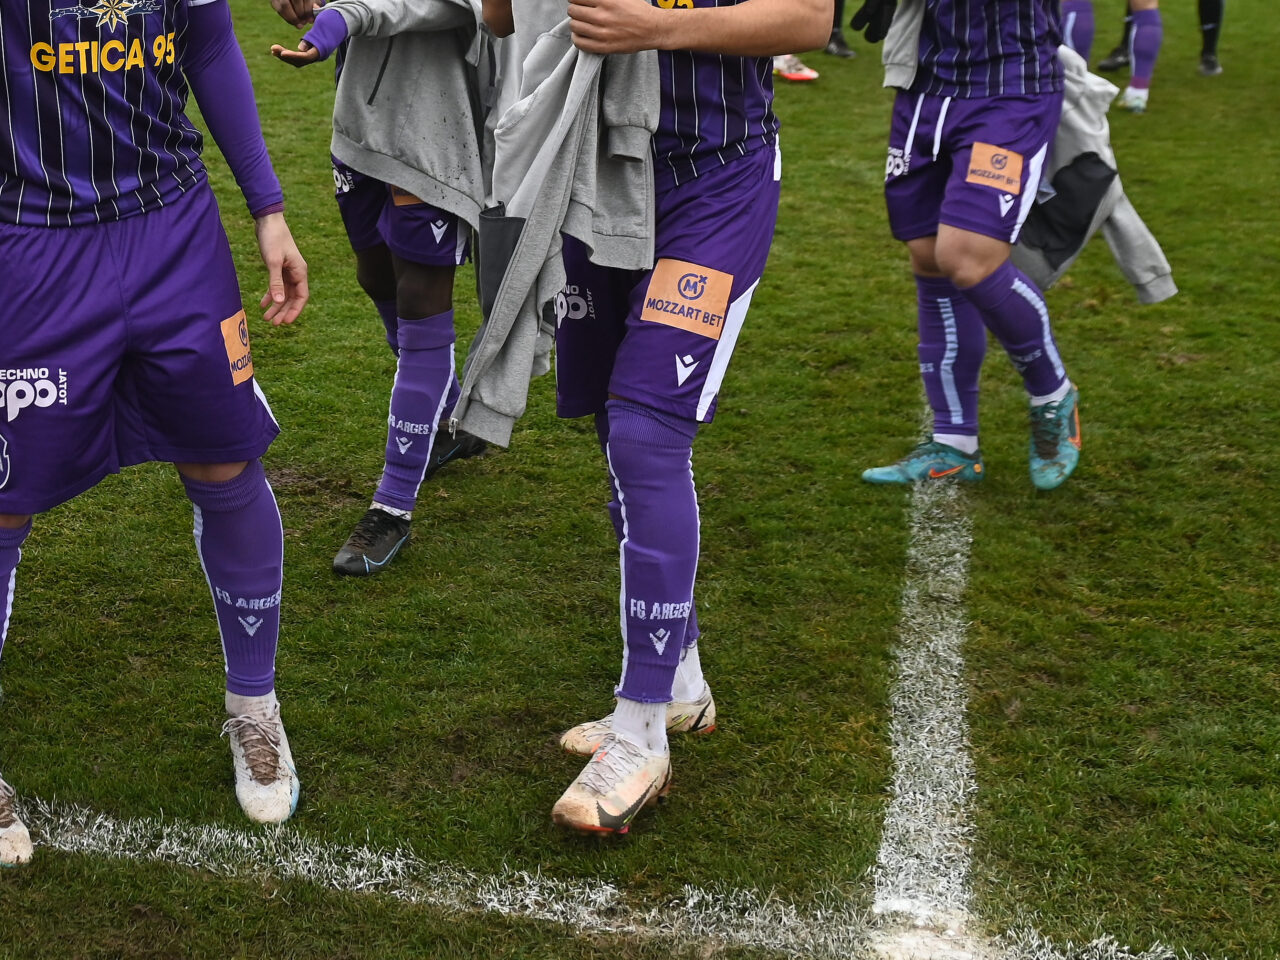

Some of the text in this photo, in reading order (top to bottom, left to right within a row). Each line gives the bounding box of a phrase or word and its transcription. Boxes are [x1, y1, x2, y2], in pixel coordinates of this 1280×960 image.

[29, 32, 176, 74] GETICA 95
[645, 297, 723, 328] MOZZART BET
